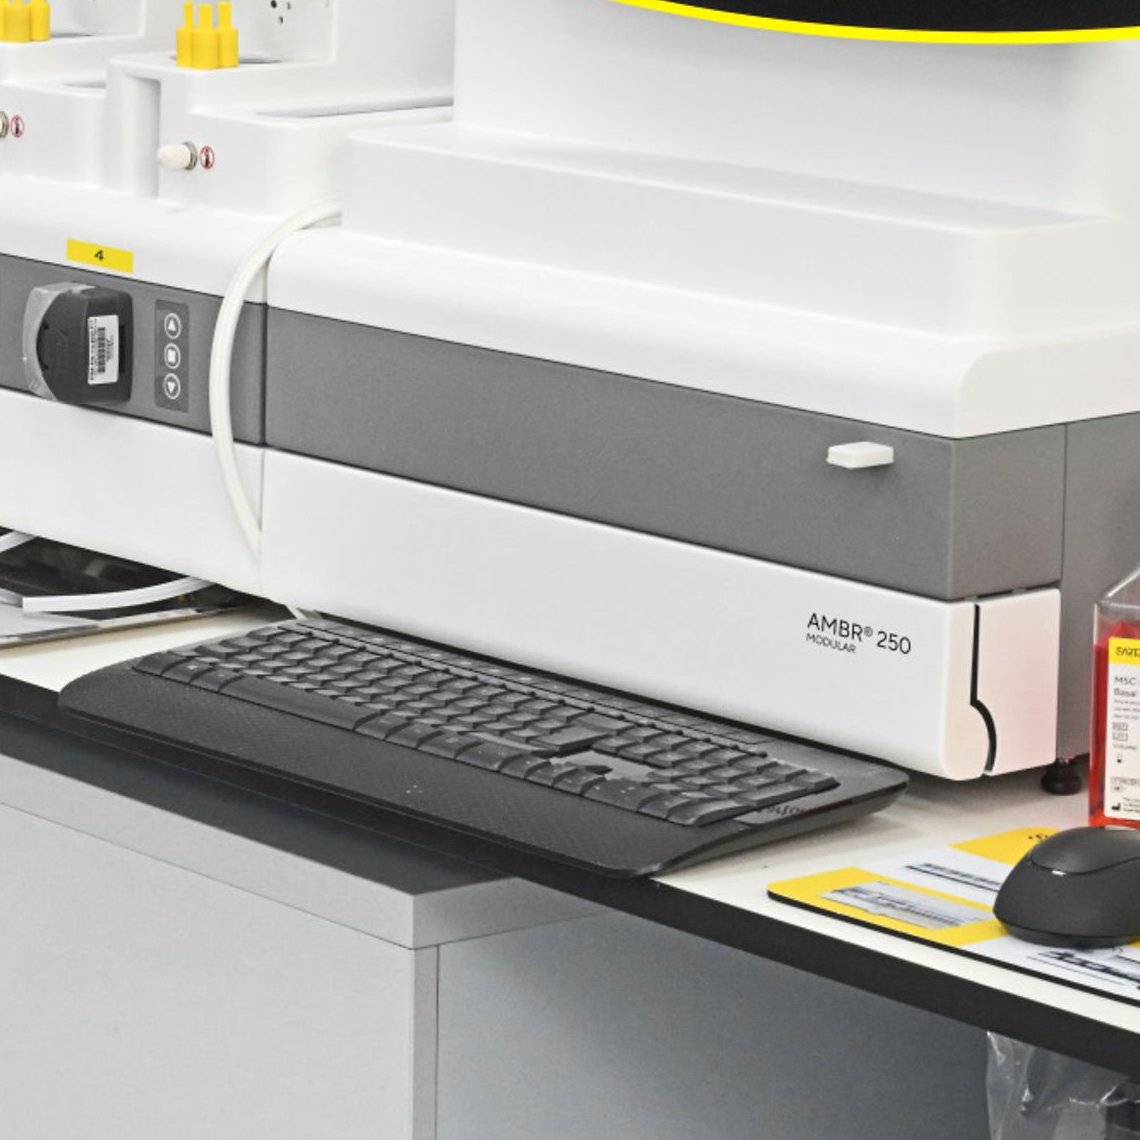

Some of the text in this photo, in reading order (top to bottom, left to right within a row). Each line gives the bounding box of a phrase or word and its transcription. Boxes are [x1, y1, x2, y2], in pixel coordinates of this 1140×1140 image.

[94, 249, 105, 262] 4
[805, 632, 857, 654] MODULAR
[876, 630, 912, 655] 250
[1114, 675, 1136, 686] MSC
